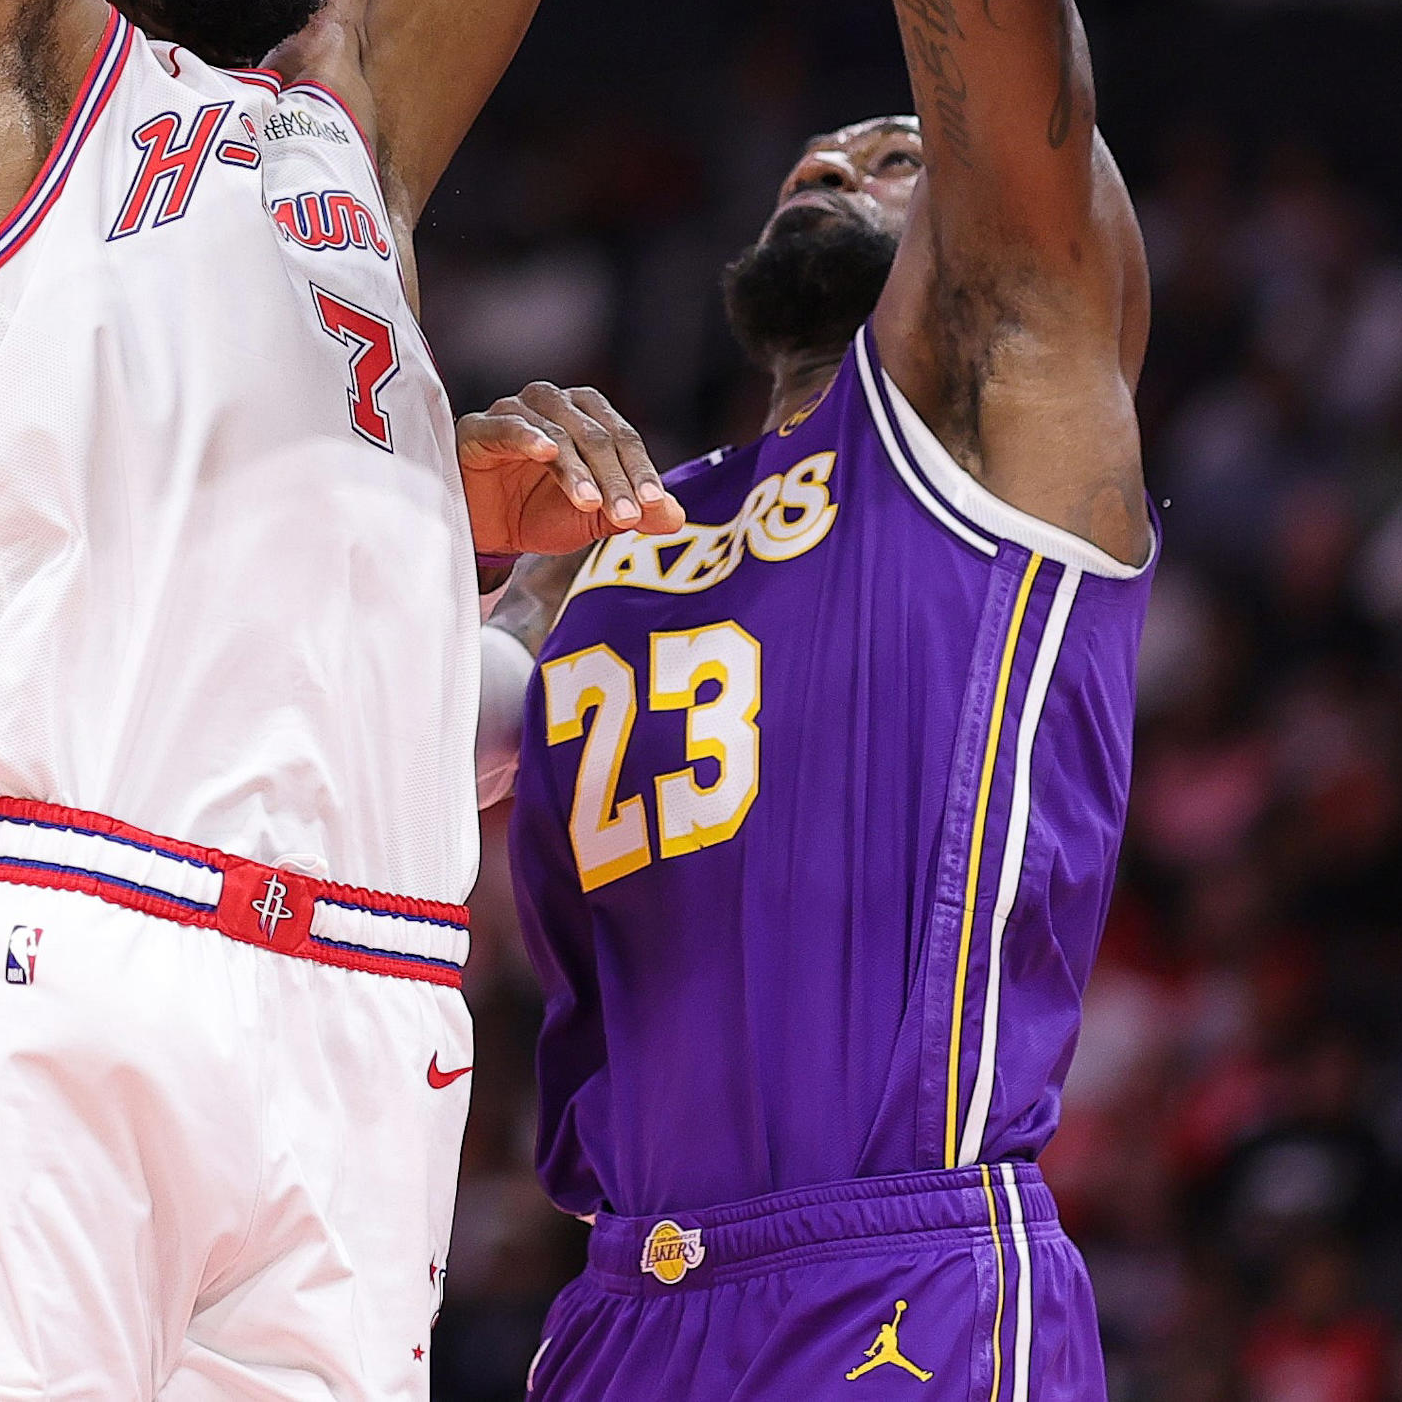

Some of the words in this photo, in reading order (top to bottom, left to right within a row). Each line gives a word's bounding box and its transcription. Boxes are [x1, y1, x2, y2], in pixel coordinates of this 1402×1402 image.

[309, 280, 400, 455] 7
[541, 619, 762, 894] 23
[645, 1239, 702, 1269] LAKERS
